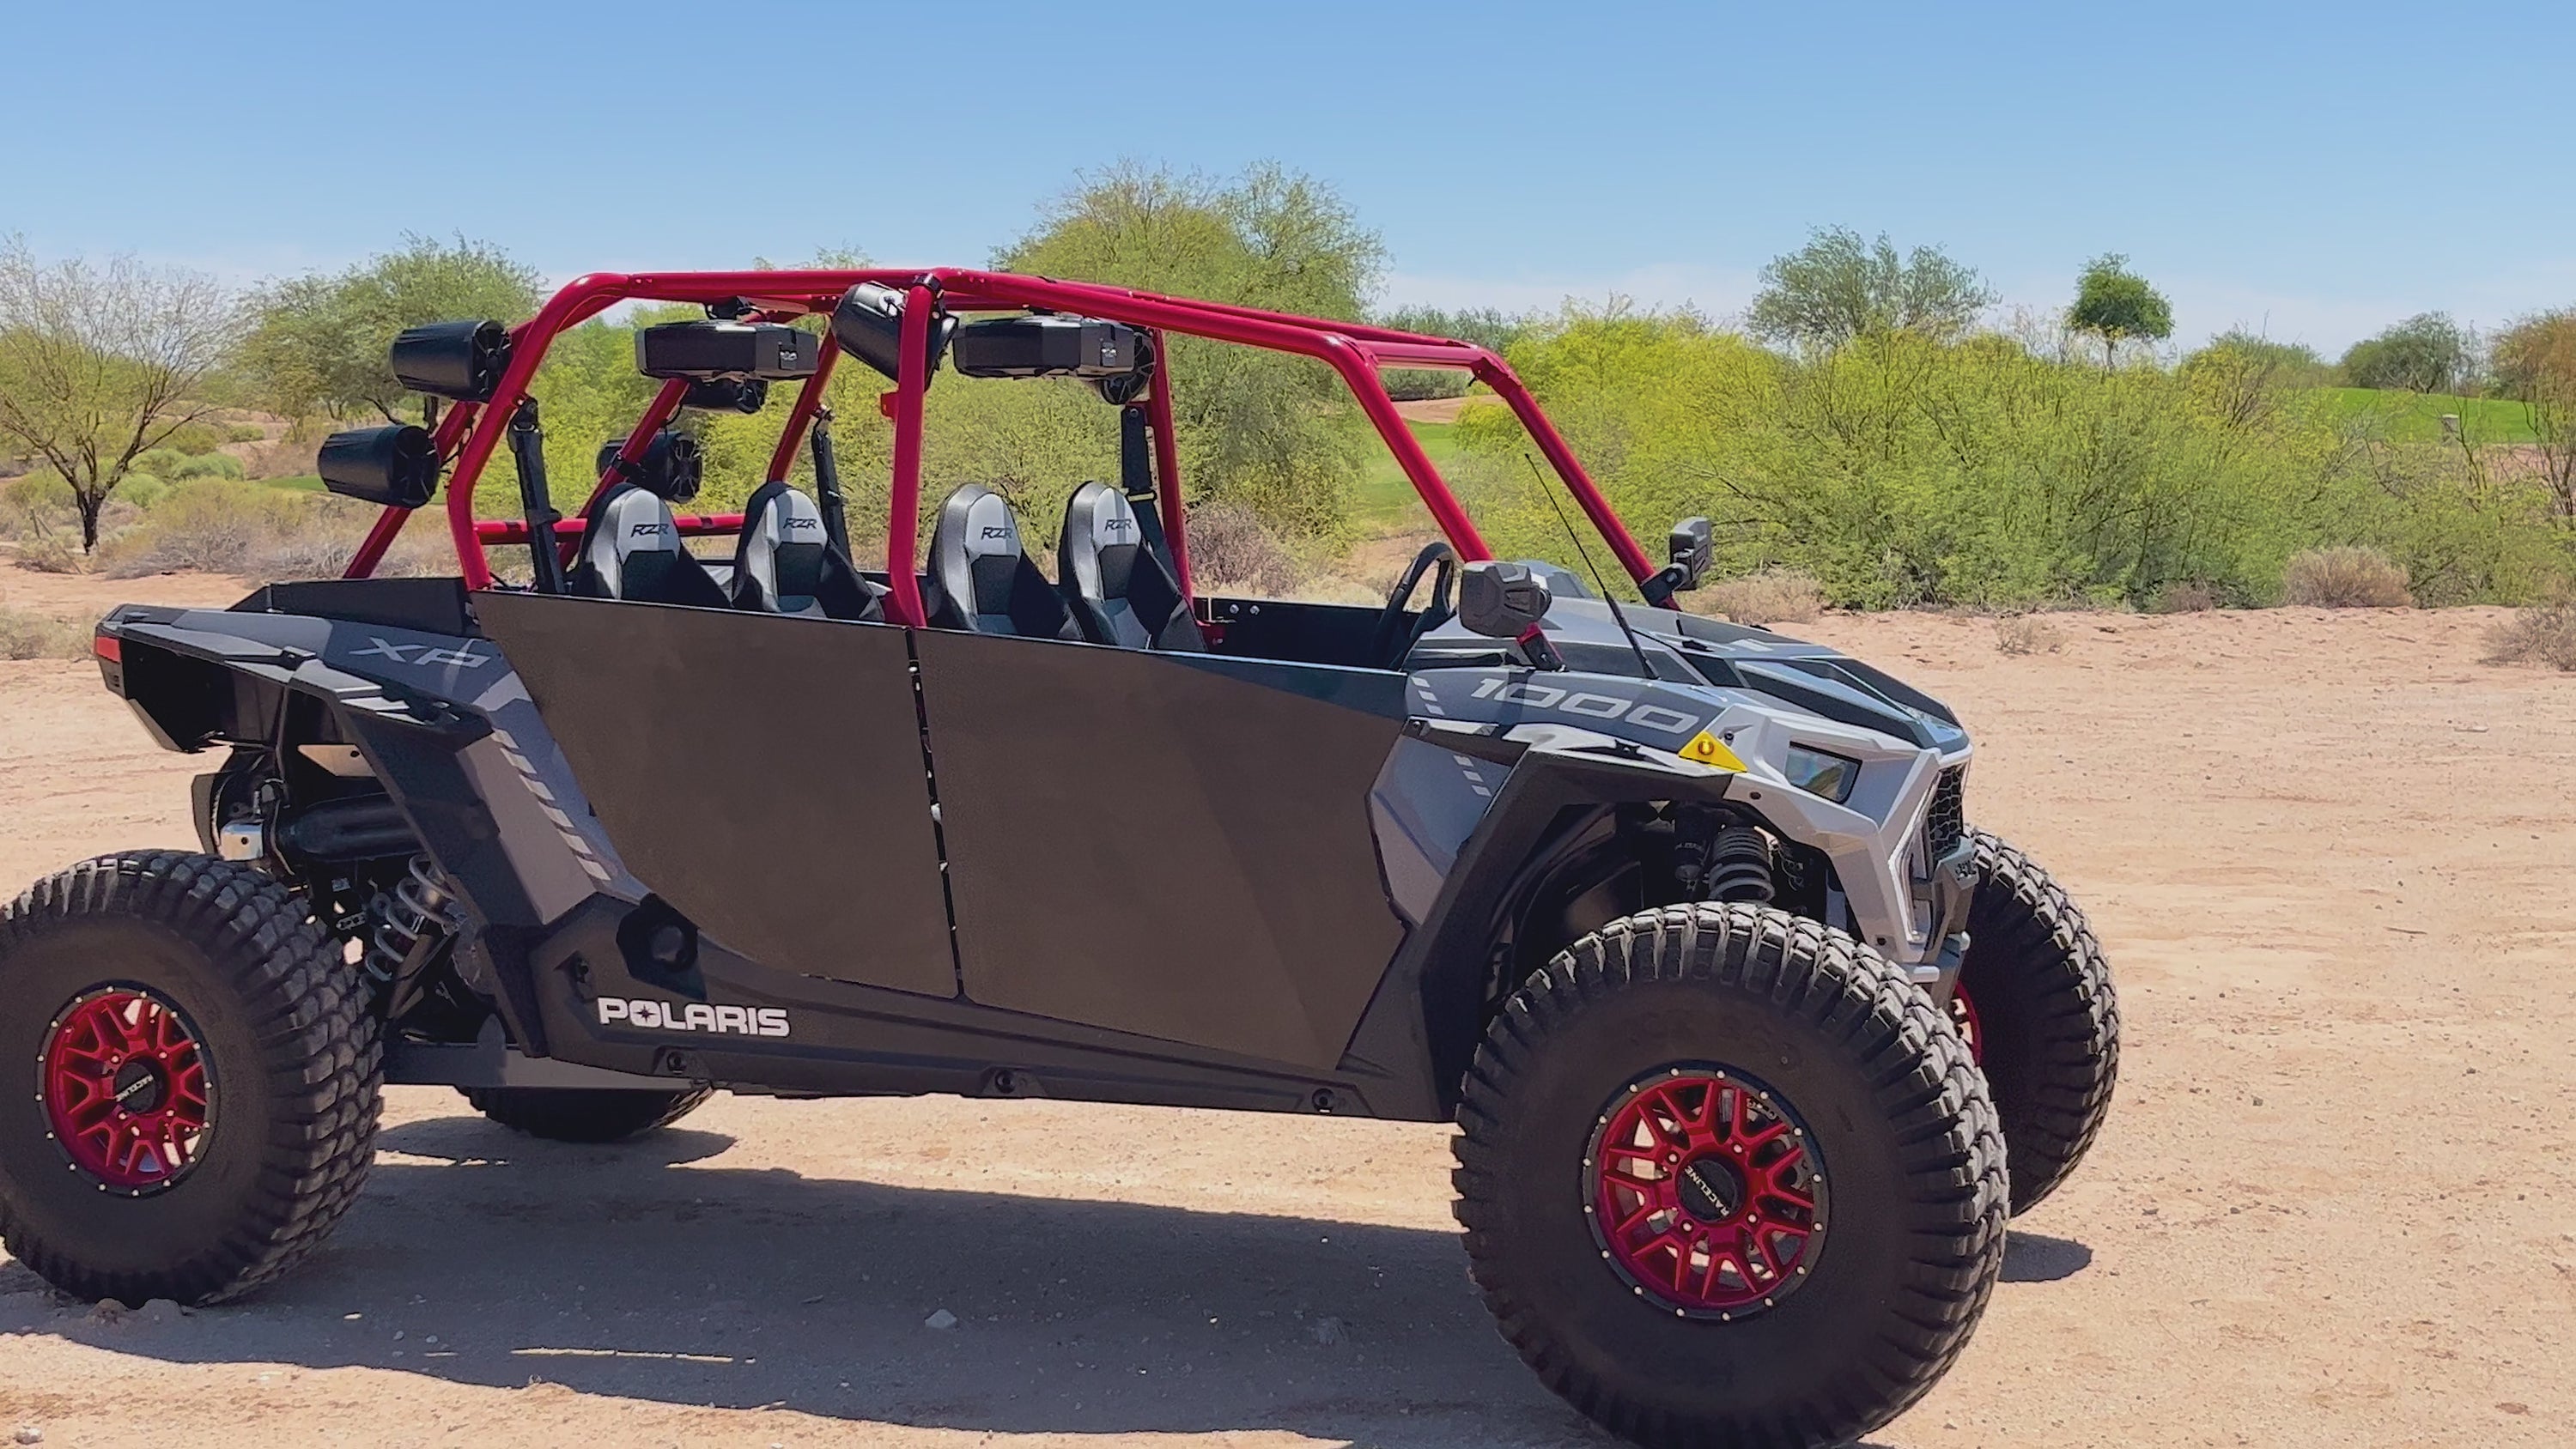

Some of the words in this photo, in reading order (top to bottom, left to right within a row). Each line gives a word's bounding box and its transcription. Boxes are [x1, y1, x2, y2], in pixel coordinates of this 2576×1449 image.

[630, 524, 669, 537] RZR
[782, 517, 817, 530] RZR
[981, 526, 1013, 540] RZR
[1104, 518, 1132, 531] RZR
[349, 636, 491, 668] XP
[1471, 678, 1699, 734] 1000
[598, 997, 790, 1037] POLARIS
[1684, 1165, 1730, 1216] RACELINE
